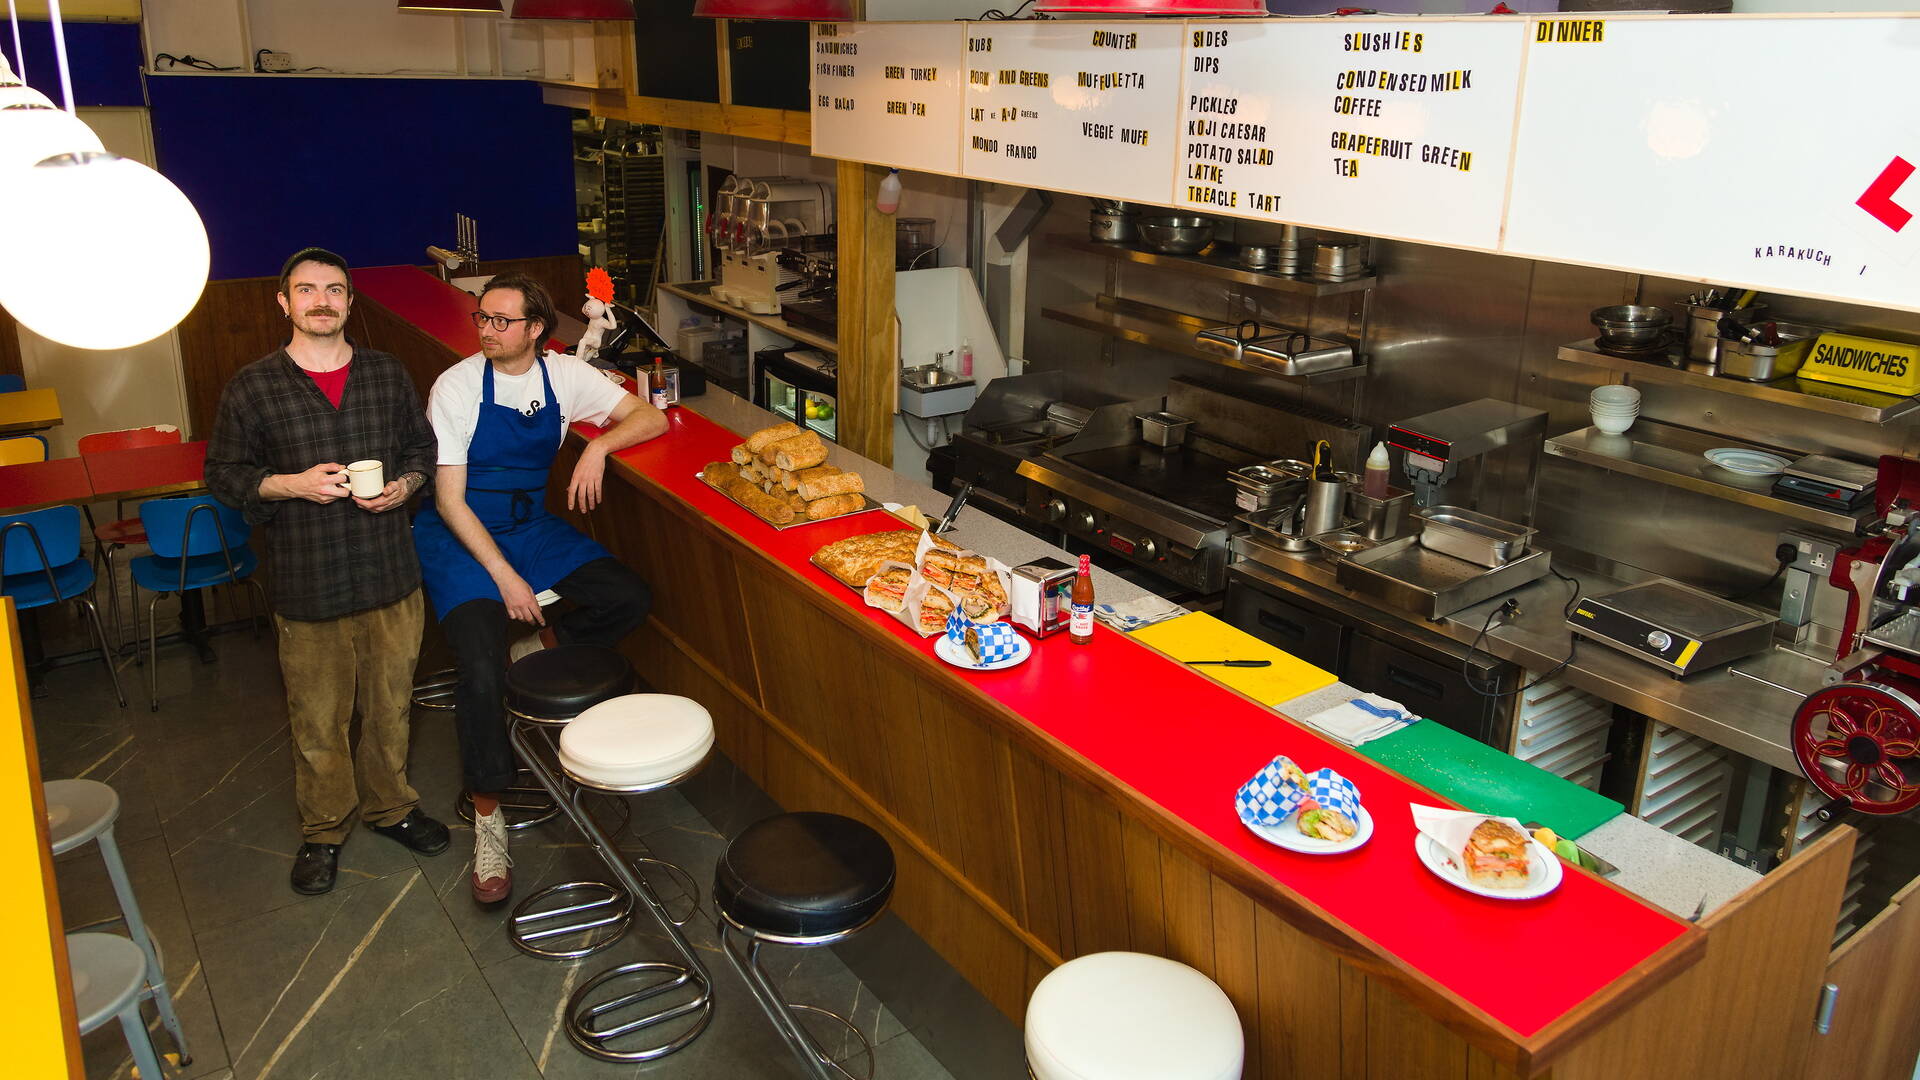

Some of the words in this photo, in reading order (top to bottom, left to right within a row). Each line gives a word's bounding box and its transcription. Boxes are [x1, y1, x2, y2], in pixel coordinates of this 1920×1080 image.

[1092, 30, 1137, 50] COUNTER
[1193, 30, 1228, 48] SIDES
[1536, 20, 1605, 42] DINNER
[816, 42, 858, 55] SANDWICHES
[969, 38, 992, 52] SUBS
[1344, 31, 1424, 52] SLUSHIES
[817, 63, 830, 76] FISH
[832, 65, 855, 77] FINGER
[885, 66, 905, 79] GREEN
[910, 68, 937, 80] TURKEY
[1194, 56, 1219, 73] DIPS
[970, 70, 989, 86] PORK
[999, 69, 1016, 84] AND
[1020, 70, 1049, 88] GREENS
[1078, 72, 1144, 90] MUFFULETTA
[1336, 70, 1426, 92] CONDENSED
[1431, 70, 1472, 92] MILK
[818, 96, 829, 107] EGG
[834, 98, 855, 111] SALAD
[887, 101, 907, 114] GREEN
[1190, 96, 1237, 114] PICKLES
[1334, 96, 1382, 117] COFFEE
[970, 108, 984, 122] LAT
[1021, 110, 1038, 119] GREENS
[1082, 122, 1113, 140] VEGGIE
[1121, 128, 1148, 146] MUFF
[1188, 120, 1217, 136] KOJI
[1221, 123, 1266, 142] CAESAR
[972, 136, 998, 153] MONDO
[1006, 144, 1037, 160] FRANGO
[1188, 143, 1232, 163] POTATO
[1238, 148, 1274, 165] SALAD
[1331, 131, 1412, 160] GRAPEFRUIT
[1422, 144, 1472, 171] GREEN
[1188, 164, 1223, 184] LATKE
[1334, 158, 1358, 177] TEA
[1188, 186, 1236, 207] TREACLE
[1249, 193, 1280, 212] TART
[1814, 344, 1909, 377] SANDWICHES
